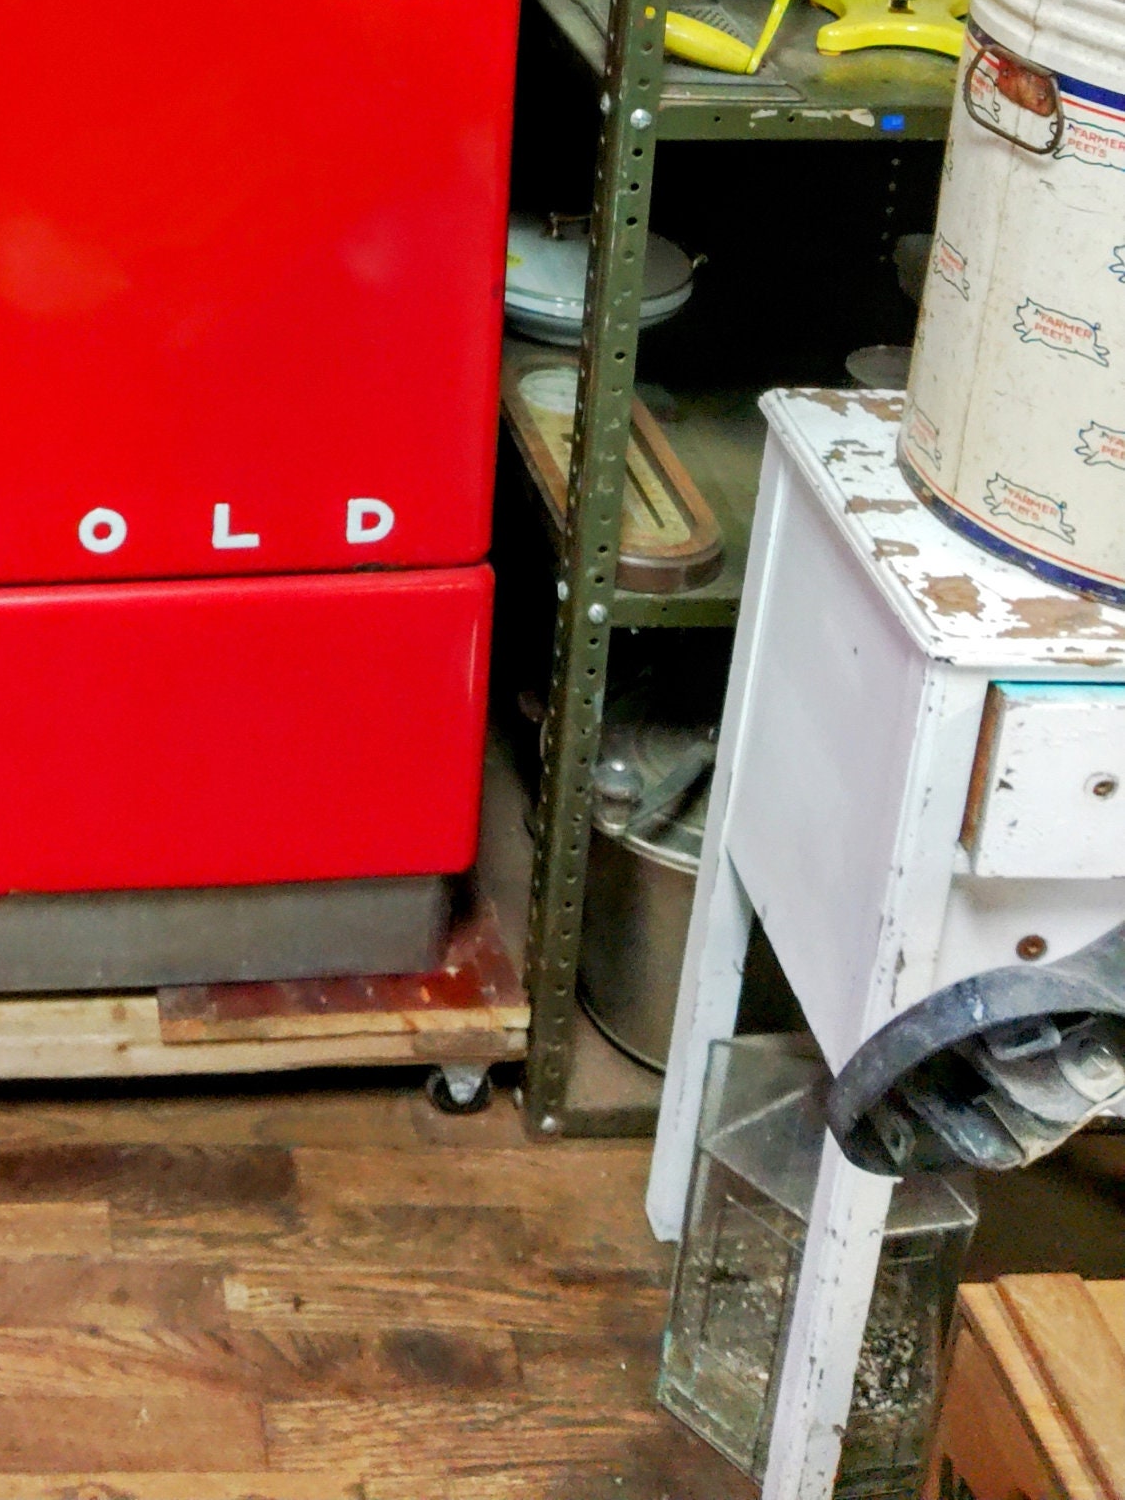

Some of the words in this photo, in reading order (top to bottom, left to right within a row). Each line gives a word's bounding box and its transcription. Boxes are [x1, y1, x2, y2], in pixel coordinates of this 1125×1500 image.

[1075, 127, 1125, 151] FARMER
[1041, 312, 1092, 339] FARMER
[1006, 487, 1059, 517] FARMER
